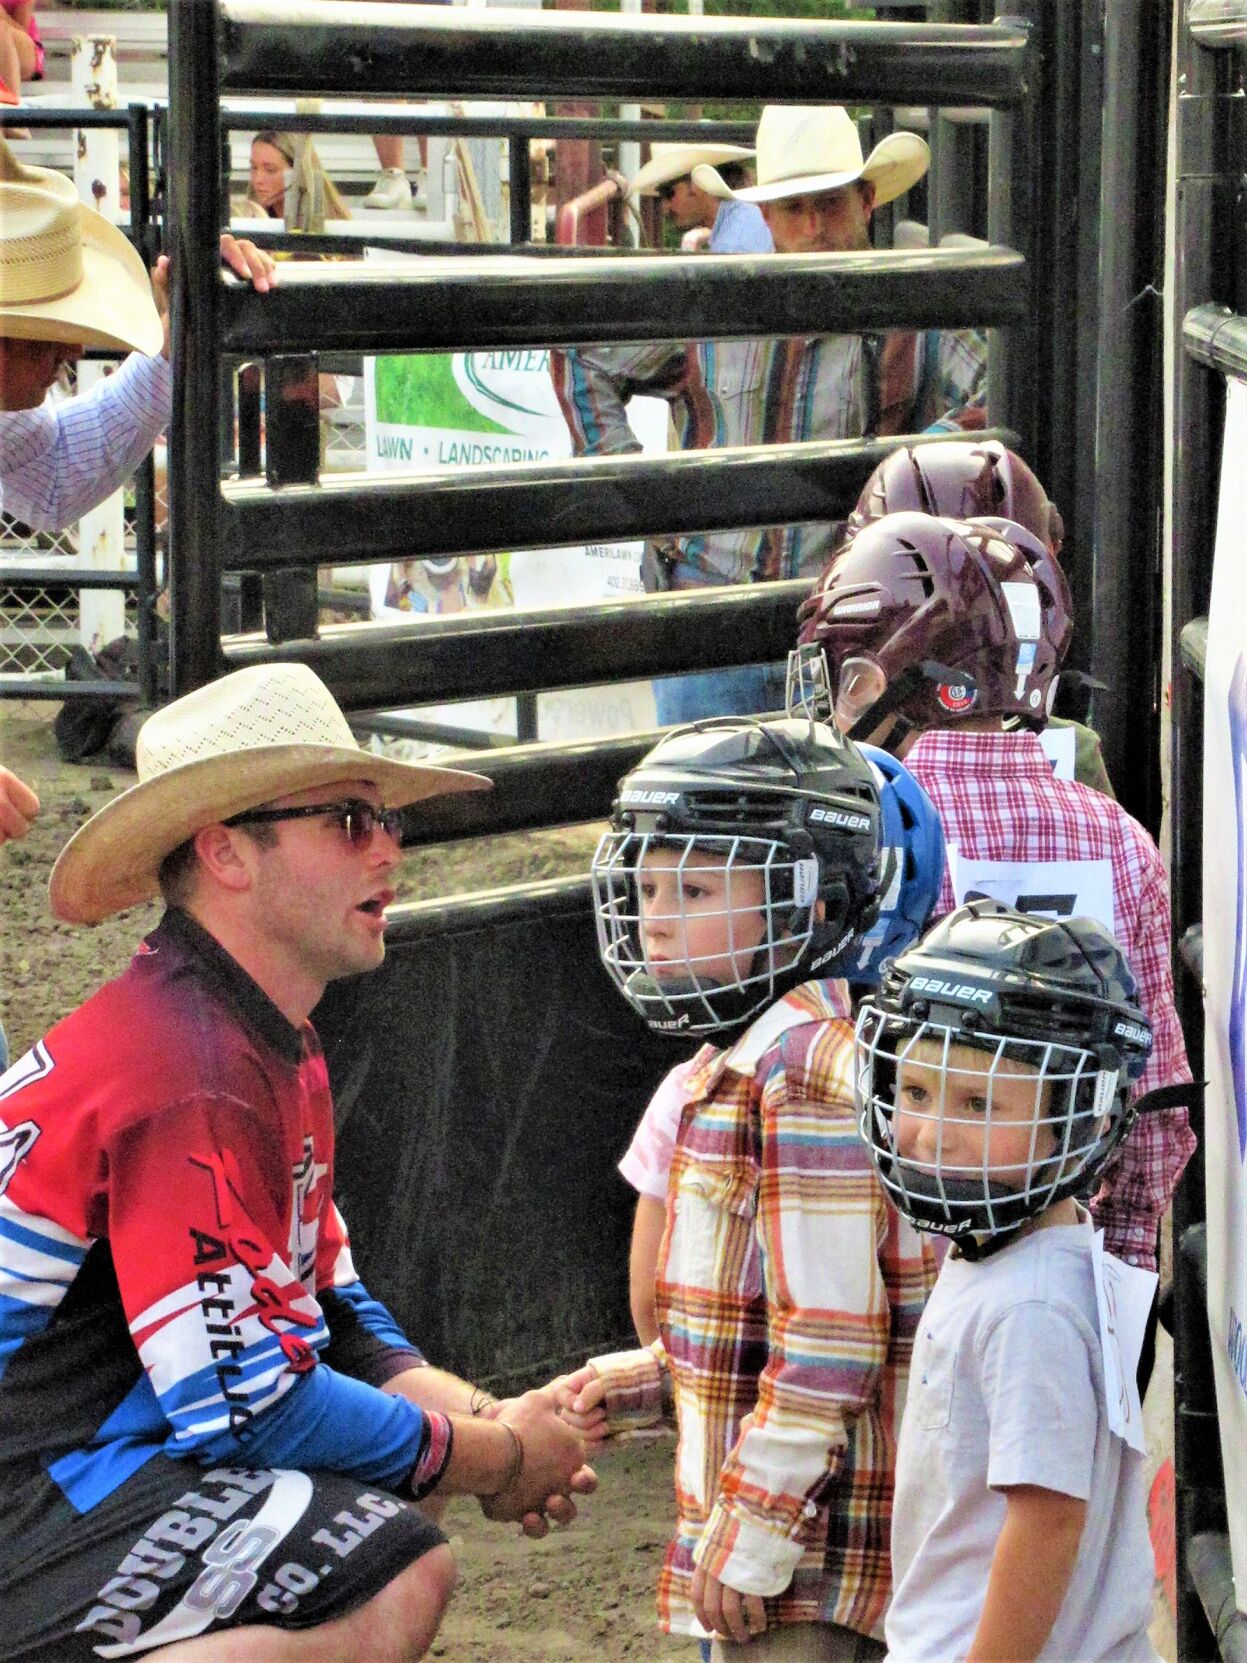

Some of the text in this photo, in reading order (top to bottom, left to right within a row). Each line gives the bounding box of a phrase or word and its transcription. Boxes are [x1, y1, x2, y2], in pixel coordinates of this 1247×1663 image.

[376, 434, 413, 460] LAWN
[619, 790, 681, 805] BAUER
[810, 808, 871, 831] BAUER
[910, 976, 994, 1003] BAUER
[647, 1013, 690, 1029] AUER
[911, 1218, 972, 1233] AUER
[75, 1467, 279, 1644] DOUBLE
[257, 1561, 332, 1614] CO.
